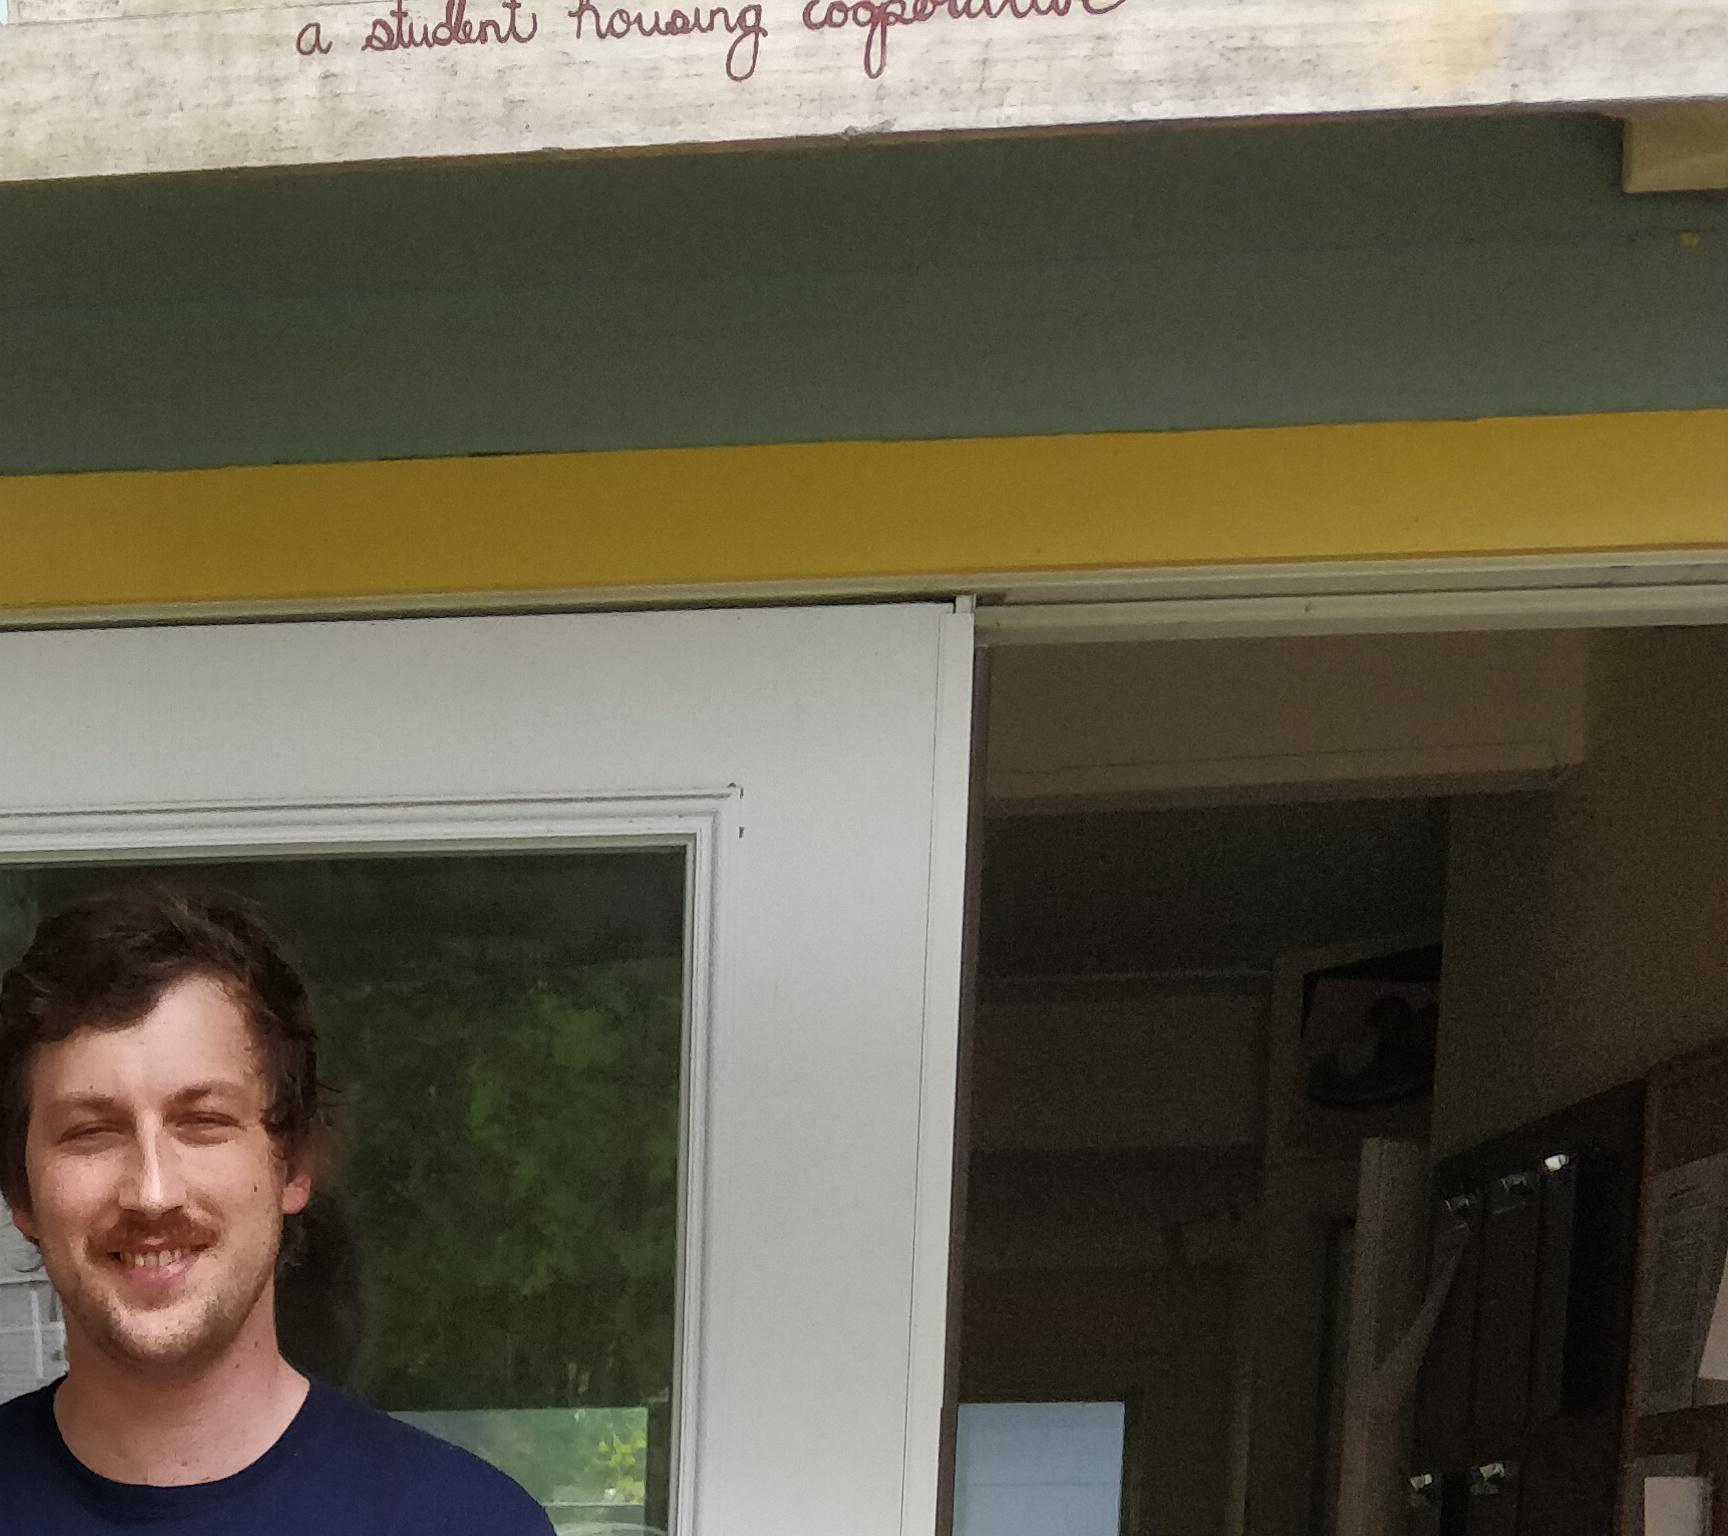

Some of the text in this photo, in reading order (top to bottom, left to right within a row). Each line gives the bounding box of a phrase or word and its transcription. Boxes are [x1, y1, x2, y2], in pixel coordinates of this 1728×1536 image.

[296, 22, 333, 56] a
[362, 0, 538, 51] student
[568, 0, 767, 81] housing
